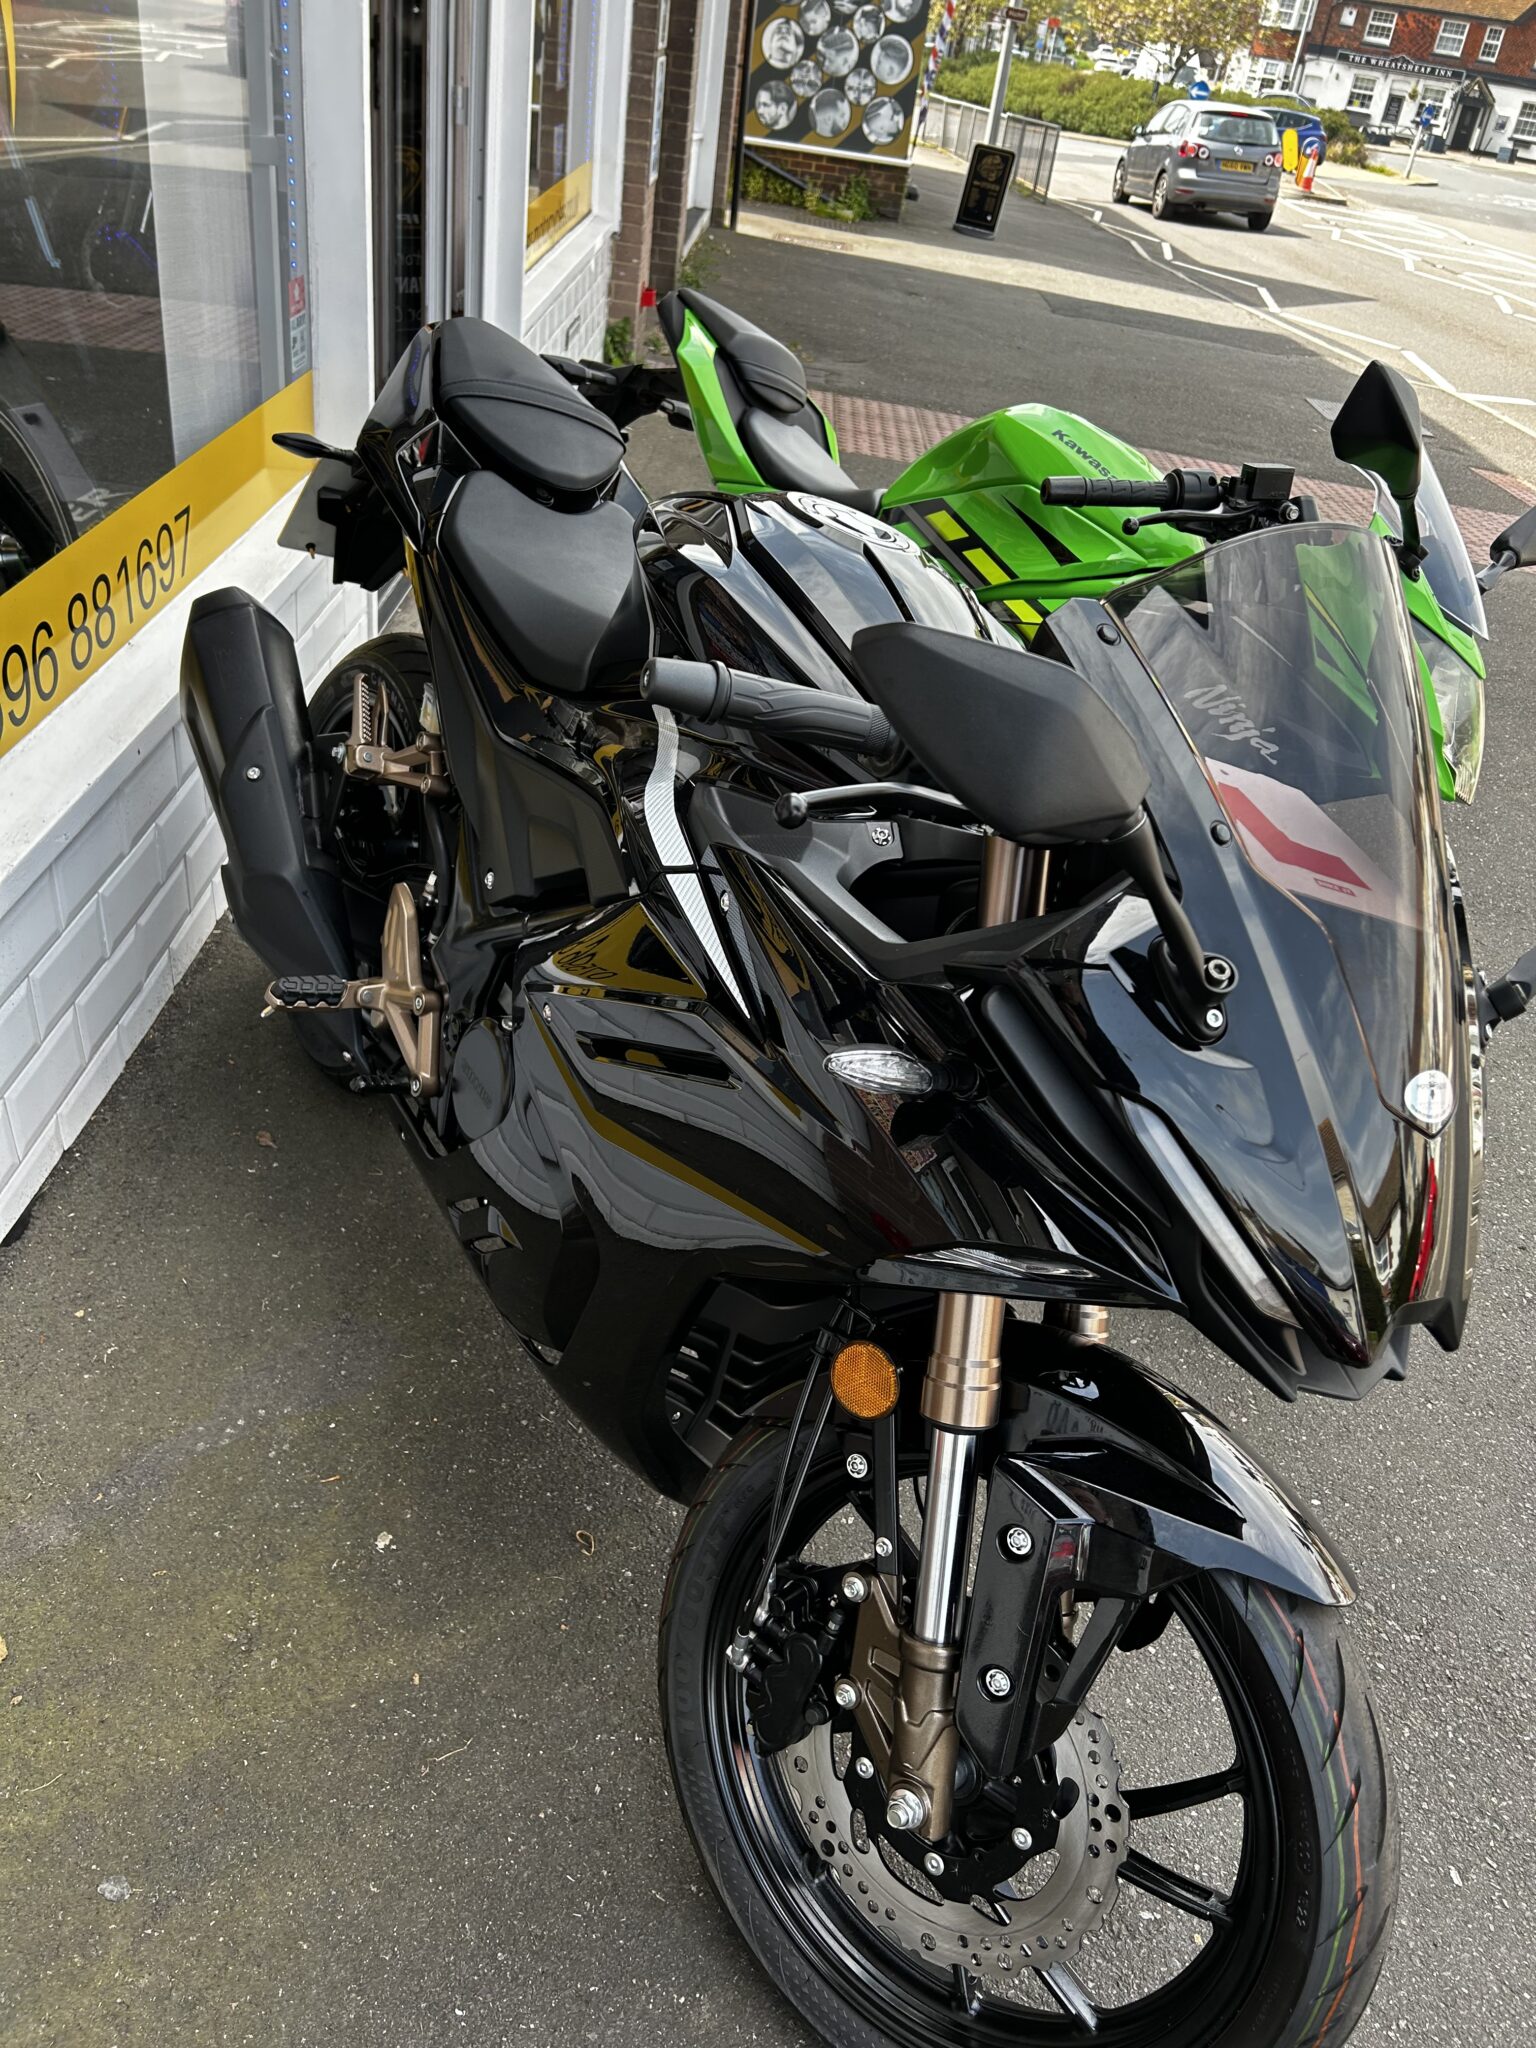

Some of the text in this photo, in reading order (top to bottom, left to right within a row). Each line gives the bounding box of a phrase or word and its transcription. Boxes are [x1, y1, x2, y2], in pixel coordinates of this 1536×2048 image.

[1348, 54, 1453, 78] THE WHEATSHEAF INN
[0, 504, 191, 740] 96 881697
[1183, 683, 1280, 766] Ninja
